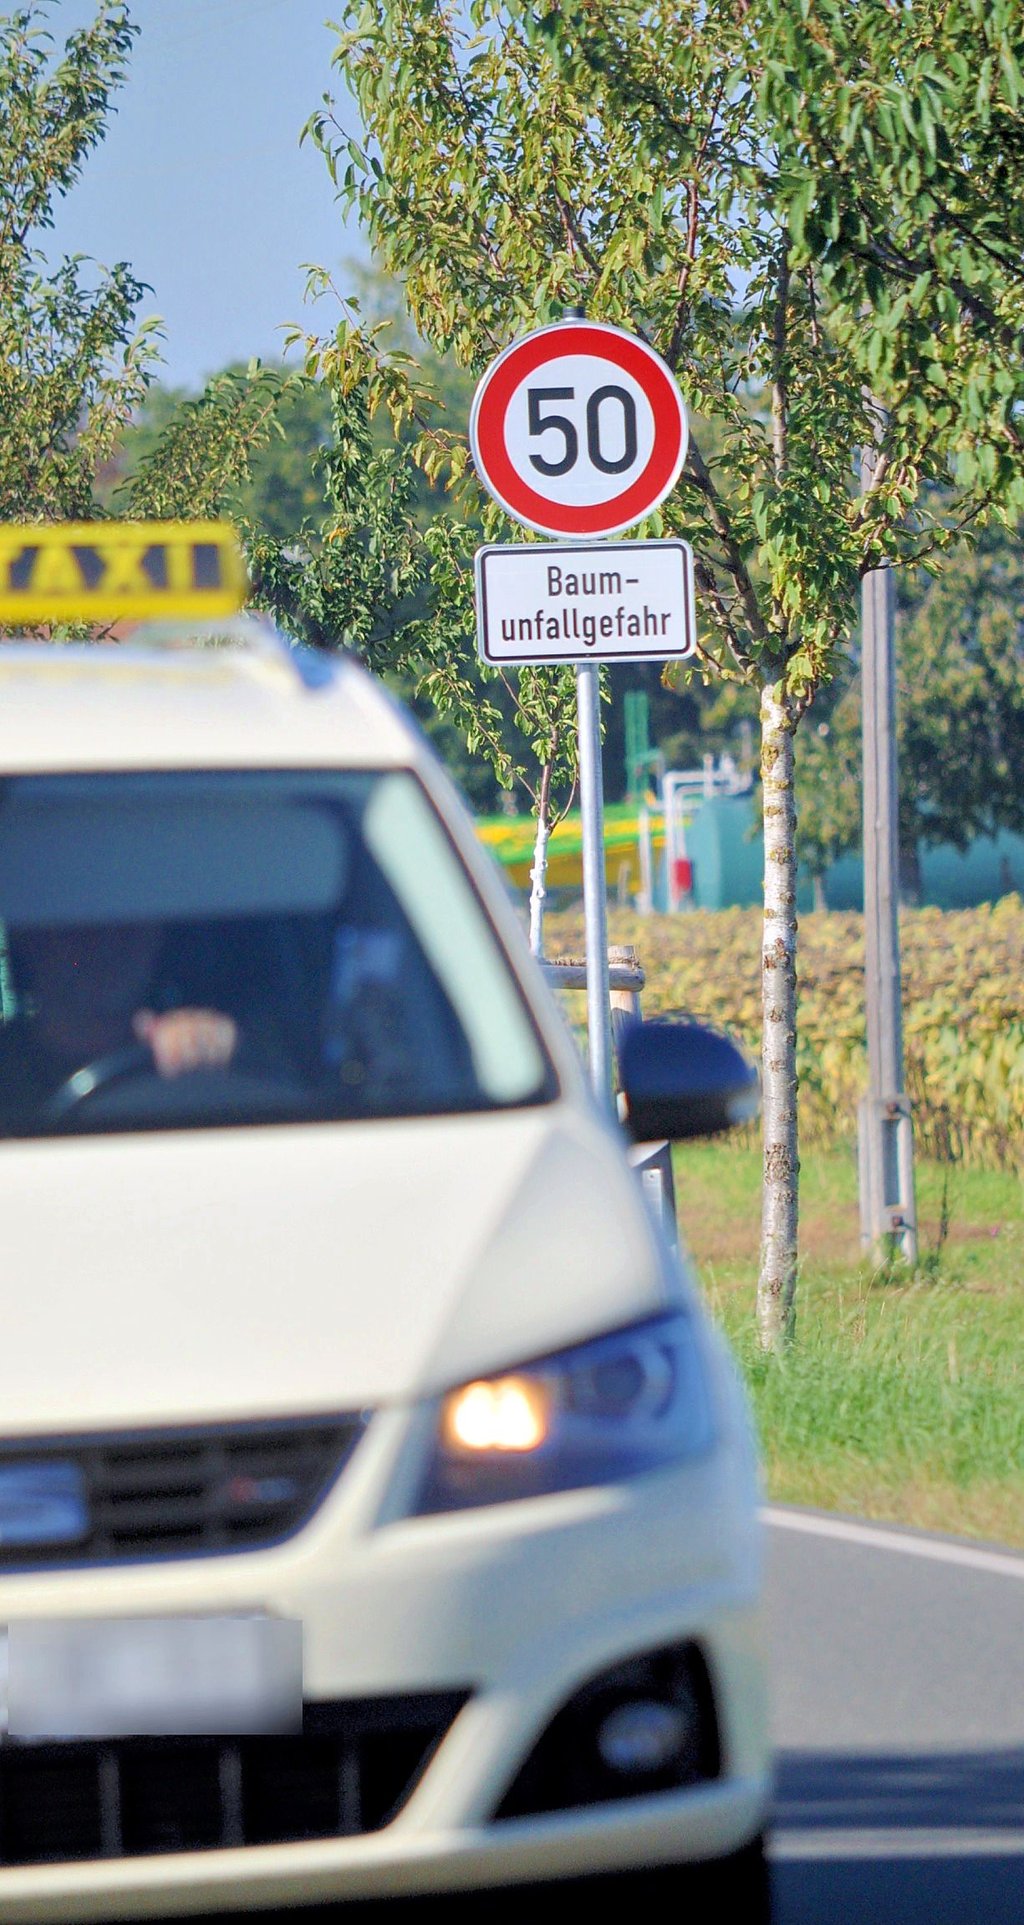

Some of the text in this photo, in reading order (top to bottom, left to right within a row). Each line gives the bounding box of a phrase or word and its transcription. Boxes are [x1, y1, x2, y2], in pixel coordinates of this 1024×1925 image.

[527, 385, 638, 477] 50
[547, 566, 640, 597] Baum-
[501, 605, 672, 647] unfallgefahr
